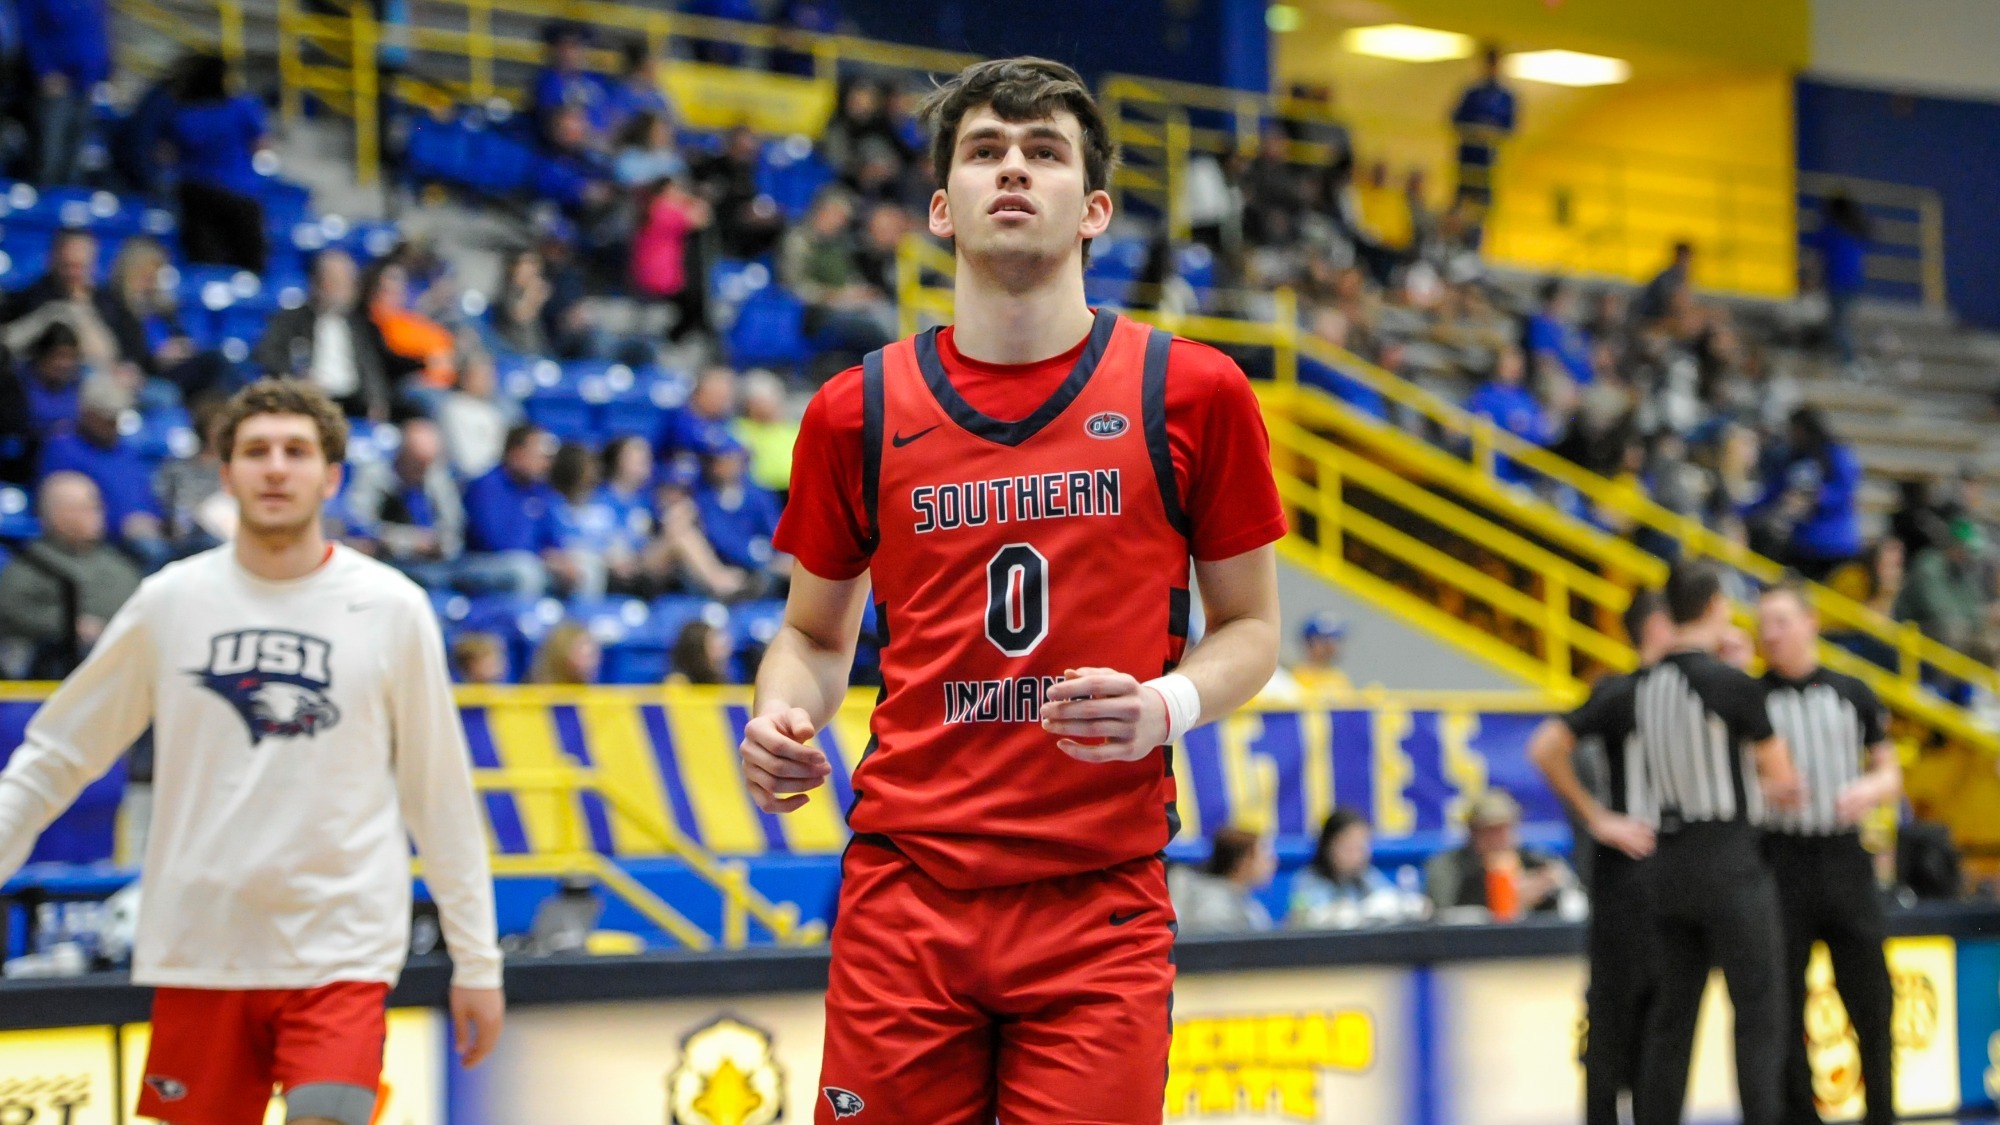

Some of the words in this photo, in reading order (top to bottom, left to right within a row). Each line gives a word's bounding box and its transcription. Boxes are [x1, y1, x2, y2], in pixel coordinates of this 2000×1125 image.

[1093, 420, 1119, 432] OVC
[911, 468, 1121, 534] SOUTHERN
[985, 542, 1049, 658] 0
[211, 629, 331, 684] USI
[943, 673, 1094, 725] INDIA
